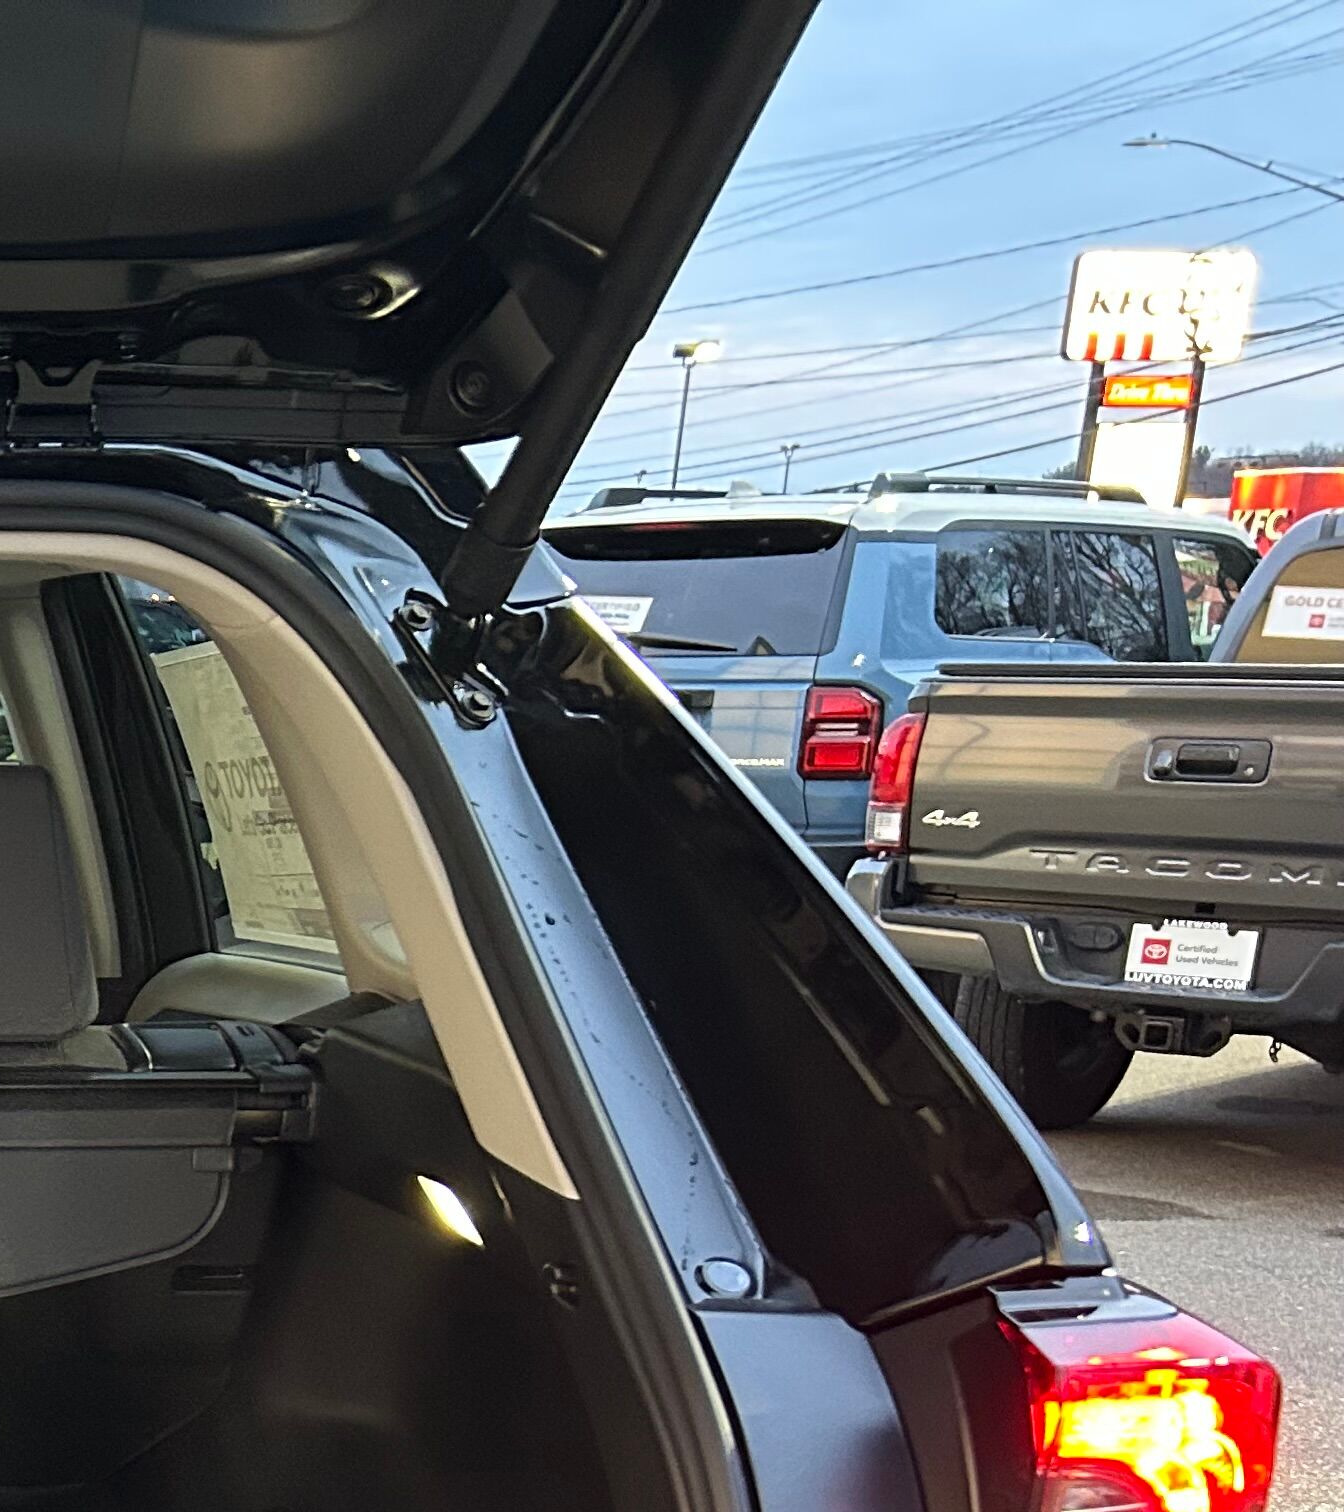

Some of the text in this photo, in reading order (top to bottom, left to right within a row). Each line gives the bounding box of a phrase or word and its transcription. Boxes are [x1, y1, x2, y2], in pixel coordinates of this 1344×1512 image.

[1231, 508, 1288, 541] KFC
[1284, 595, 1324, 608] GOLD
[217, 755, 278, 799] TOYOT
[1028, 848, 1344, 887] TACOM
[1163, 918, 1229, 930] LAKEWOOD
[1177, 943, 1219, 954] Certified
[1175, 955, 1239, 967] Used Vehicles
[1124, 971, 1247, 991] LUVTOYOTA.COM
